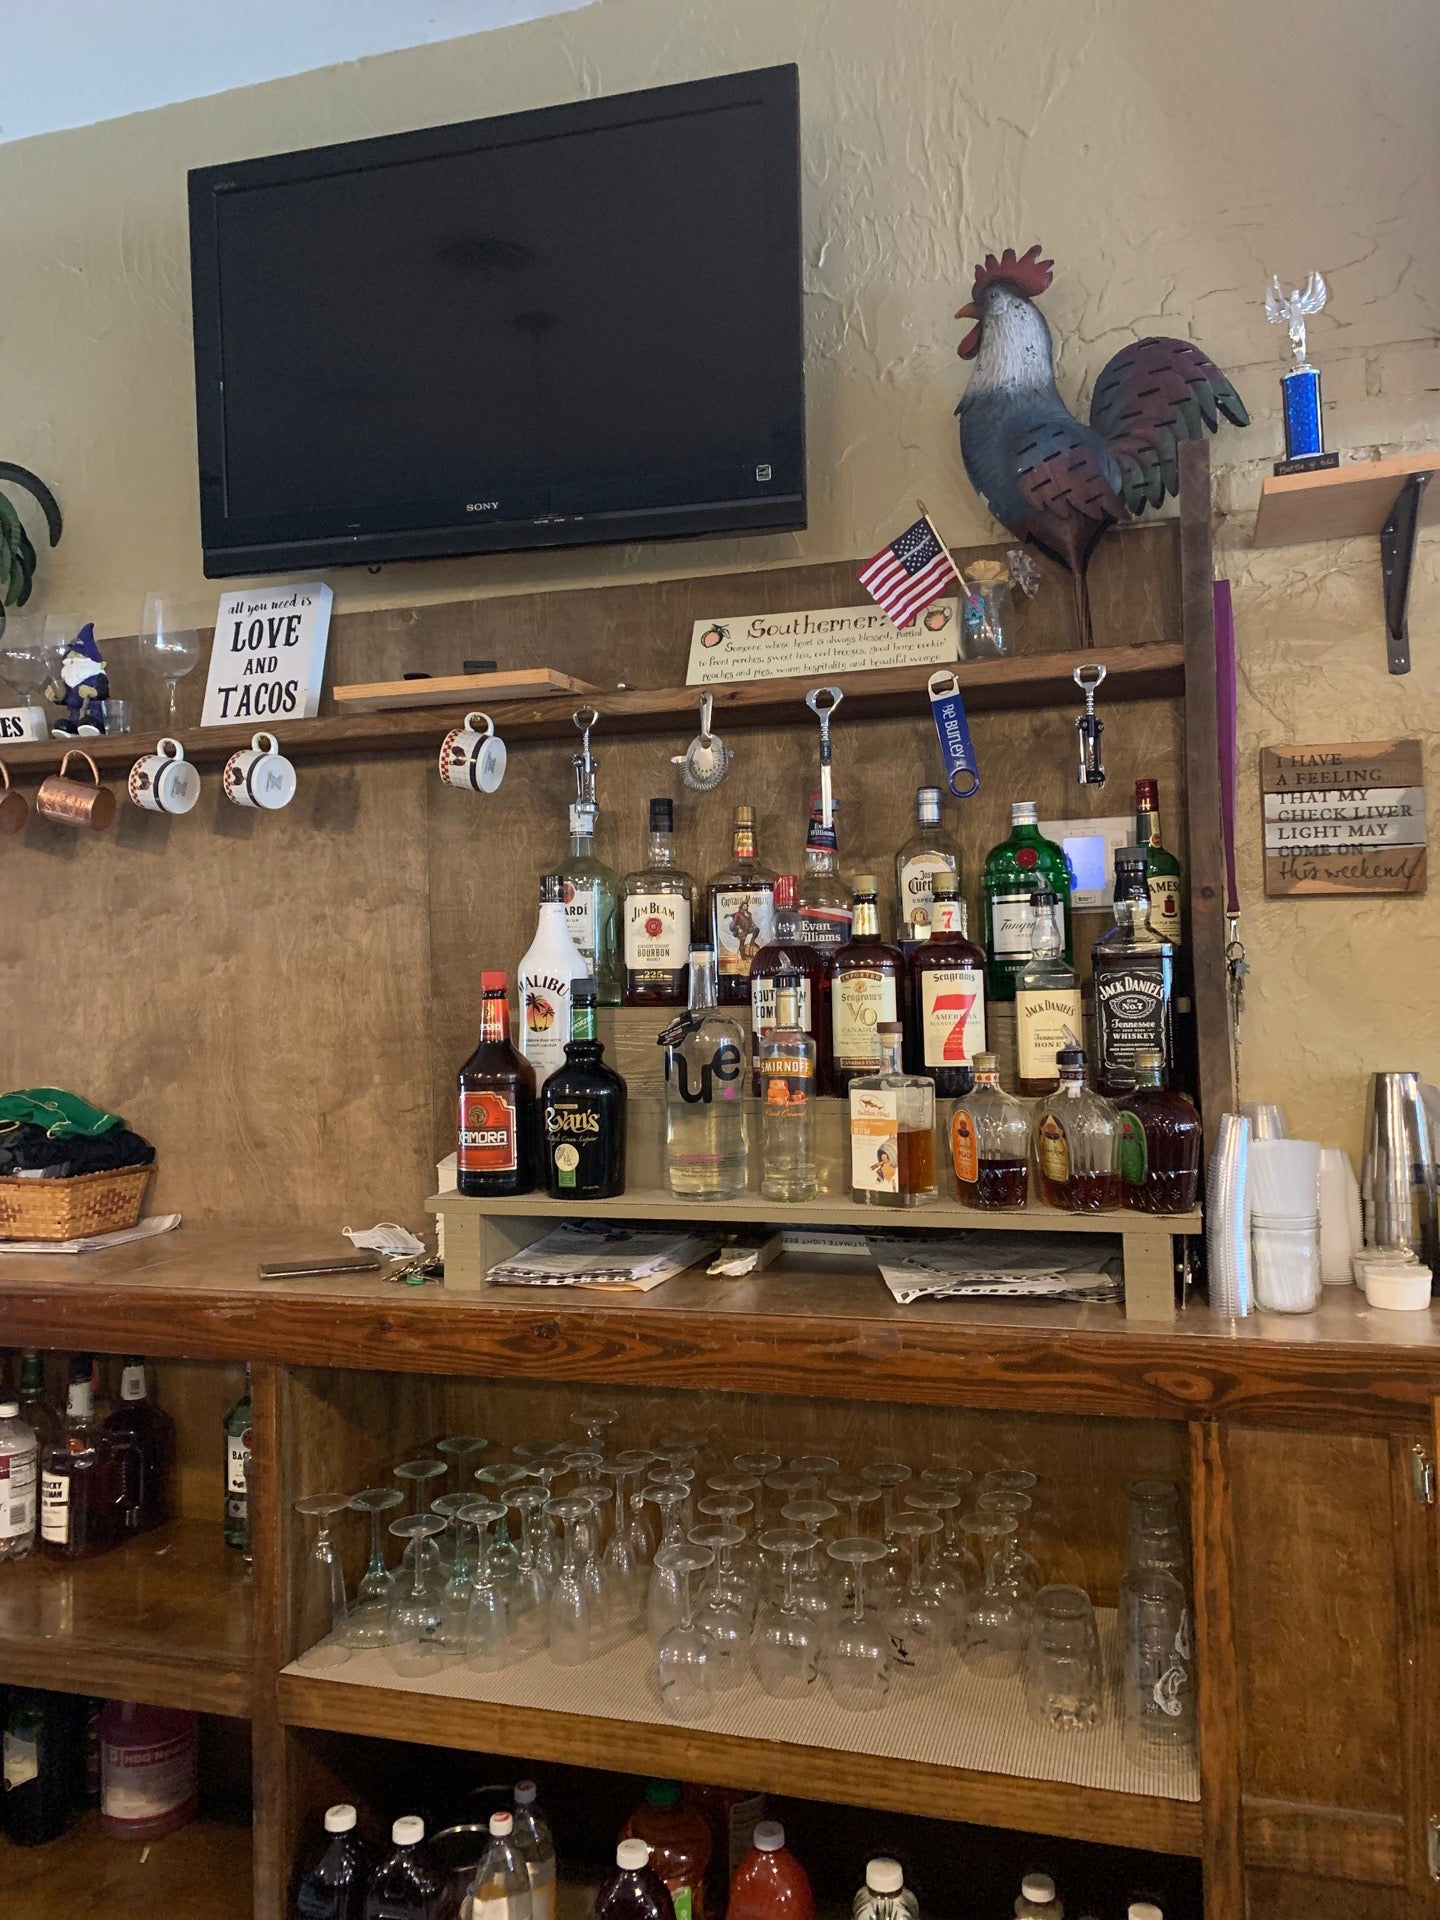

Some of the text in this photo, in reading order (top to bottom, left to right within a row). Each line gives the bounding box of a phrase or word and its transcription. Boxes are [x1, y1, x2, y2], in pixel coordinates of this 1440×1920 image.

[466, 501, 499, 512] SONY
[228, 593, 312, 618] all you need is
[230, 614, 302, 652] LOVE
[242, 656, 278, 675] AND
[218, 680, 299, 718] TACOS
[0, 716, 24, 738] ES
[1276, 753, 1343, 768] I HAVE
[1276, 769, 1382, 786] A FEELING
[1277, 789, 1369, 805] THAT MY
[1278, 804, 1413, 822] CHECK LIVER
[810, 829, 835, 837] Williams
[1278, 823, 1388, 840] LIGHT MAY
[1278, 843, 1364, 858] COME ON
[920, 870, 933, 880] Jos
[1279, 857, 1317, 881] this
[908, 877, 932, 895] Cuer
[1149, 880, 1180, 894] AMES
[565, 902, 588, 916] ARDÍ
[631, 902, 675, 923] JIM BEAM
[802, 920, 831, 931] Evan
[941, 911, 953, 929] 7
[1001, 919, 1035, 932] Tanqu
[794, 931, 841, 942] Williams
[637, 948, 670, 957] BOURBON
[644, 970, 664, 979] 225
[1099, 976, 1165, 1000] JACK DANIEL'S
[754, 989, 807, 1004] SOUTN
[1025, 1000, 1074, 1018] JACK DANIEL'S
[1122, 1002, 1143, 1010] No.7
[931, 993, 977, 1060] 7
[1111, 1018, 1156, 1029] Tennessee
[761, 1060, 810, 1073] SMIRNOFF
[545, 1106, 600, 1134] Ryan's
[458, 1130, 507, 1145] KAMORA
